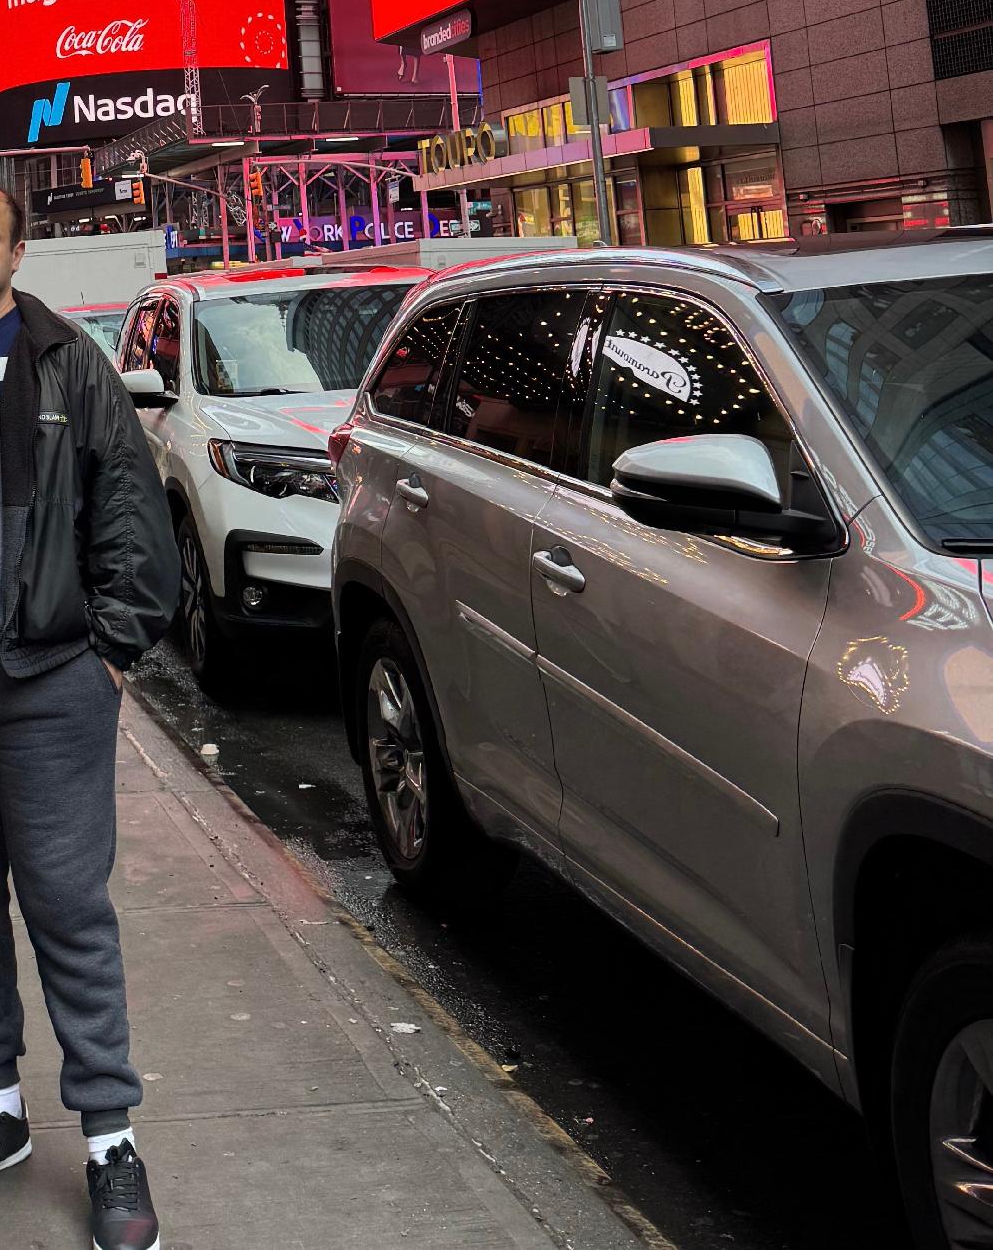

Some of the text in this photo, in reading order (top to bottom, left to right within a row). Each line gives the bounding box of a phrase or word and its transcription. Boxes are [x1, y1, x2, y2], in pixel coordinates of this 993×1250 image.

[56, 18, 149, 59] Coca-Cola
[74, 88, 198, 124] Nasdaq
[418, 121, 496, 174] TOURO
[350, 215, 414, 241] POLCE
